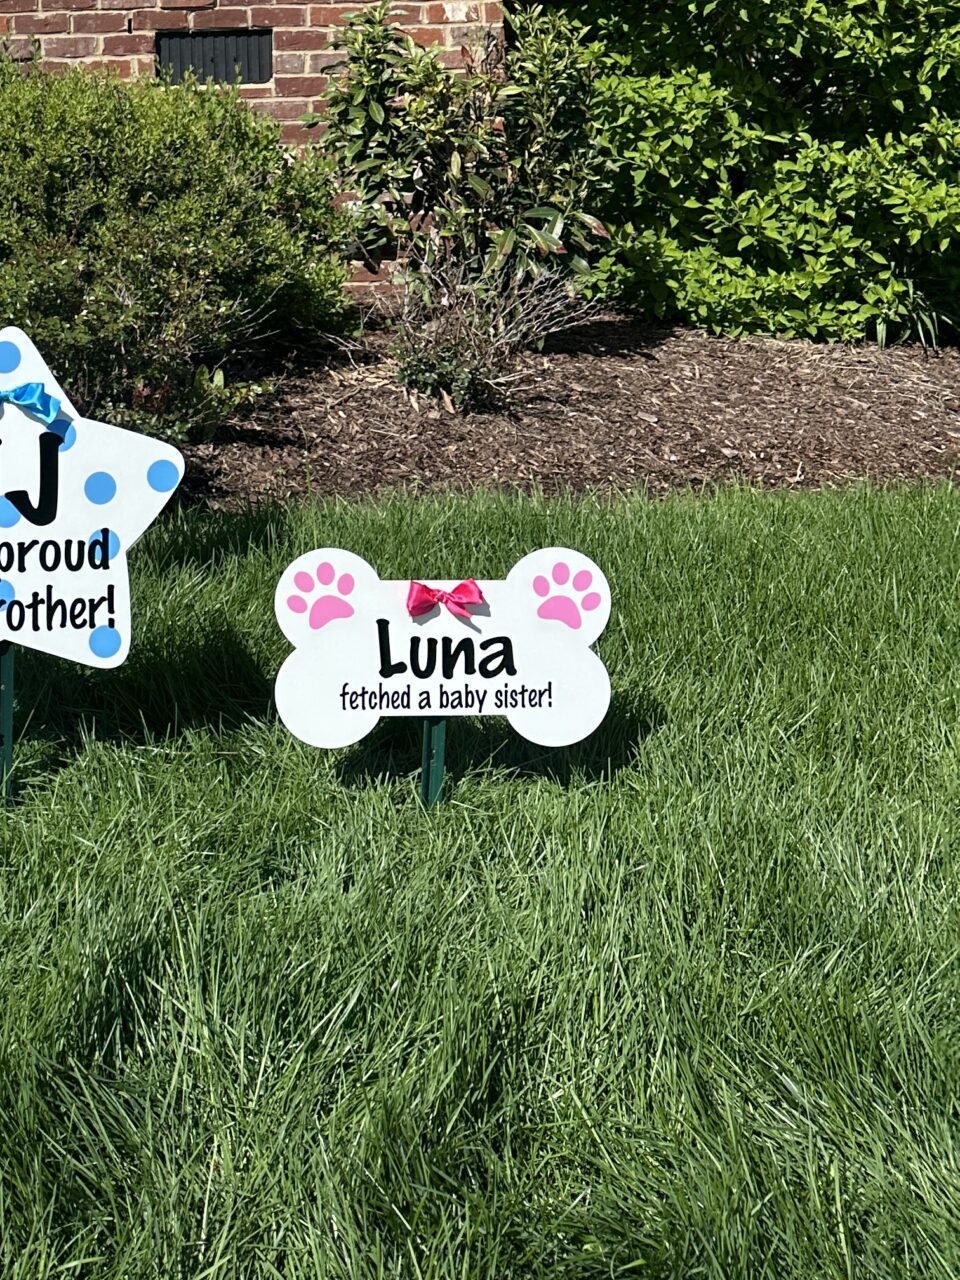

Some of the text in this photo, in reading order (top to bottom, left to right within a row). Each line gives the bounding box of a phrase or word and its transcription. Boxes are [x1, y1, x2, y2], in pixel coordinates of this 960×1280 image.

[376, 618, 517, 680] Luna
[340, 681, 553, 713] fetched a baby sister!
